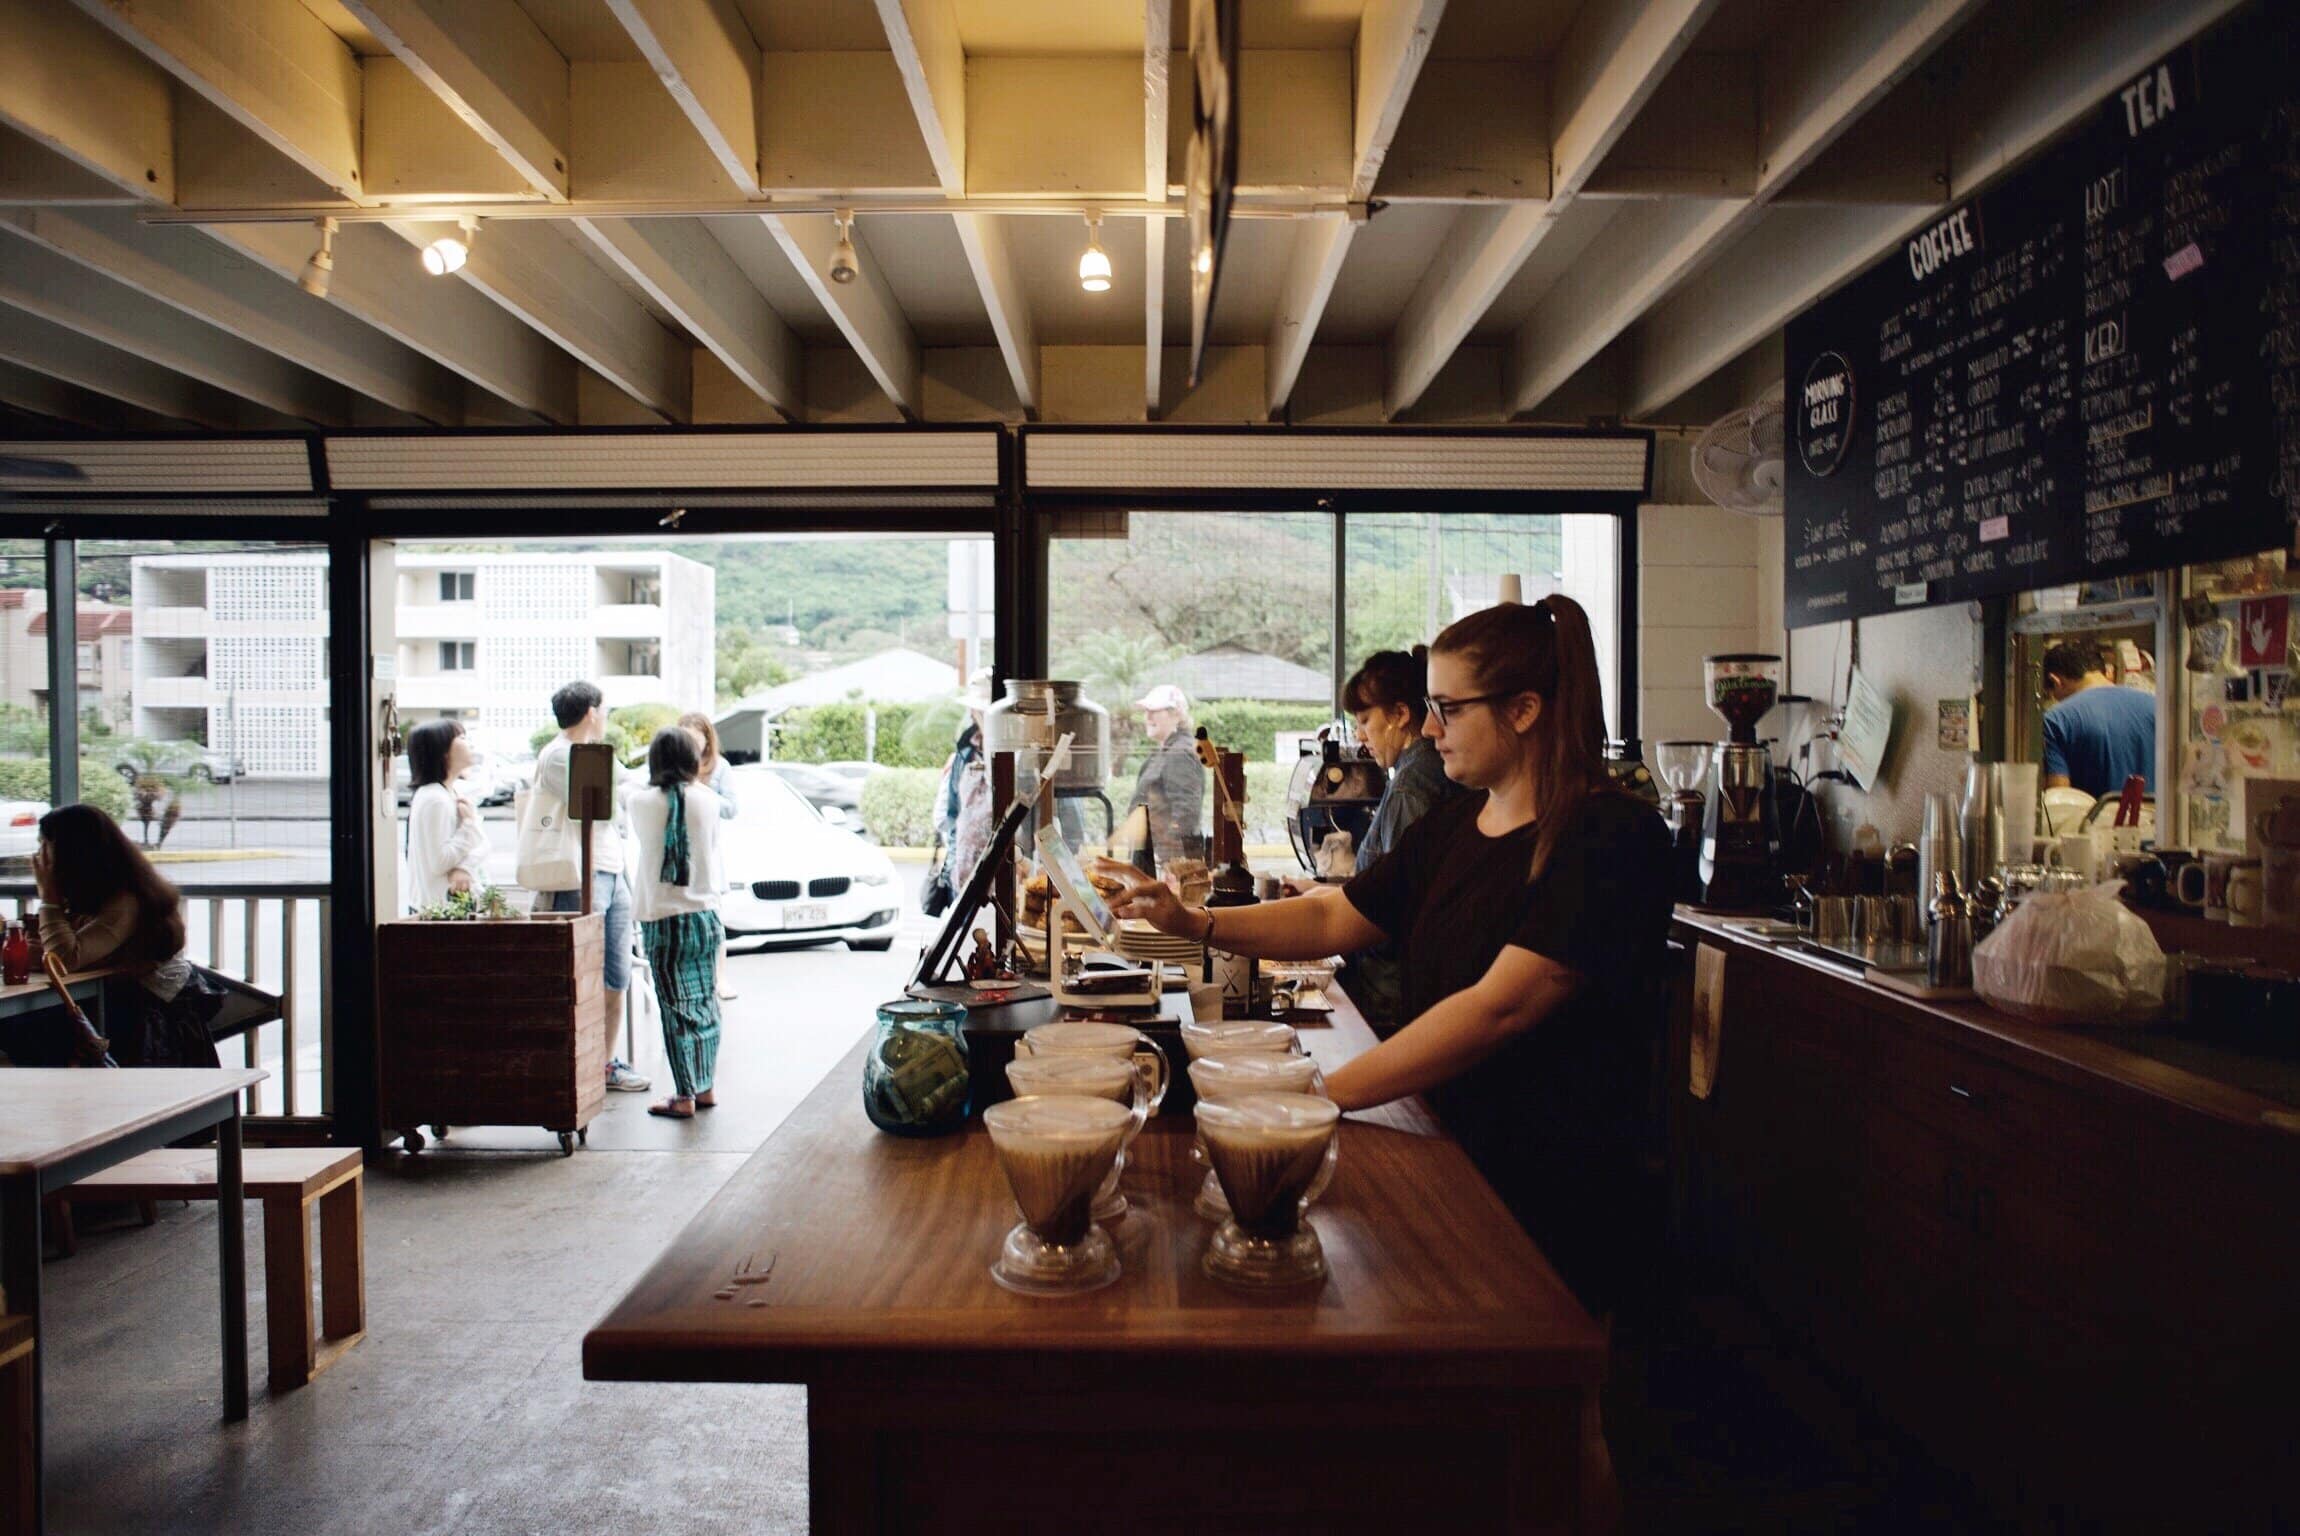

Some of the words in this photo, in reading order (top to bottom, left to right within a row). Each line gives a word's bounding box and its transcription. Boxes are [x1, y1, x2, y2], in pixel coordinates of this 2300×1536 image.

[2121, 64, 2175, 137] TEA
[1909, 207, 1974, 281] COFFEE
[1810, 400, 1840, 430] GLASS
[1969, 403, 1999, 434] LATTE
